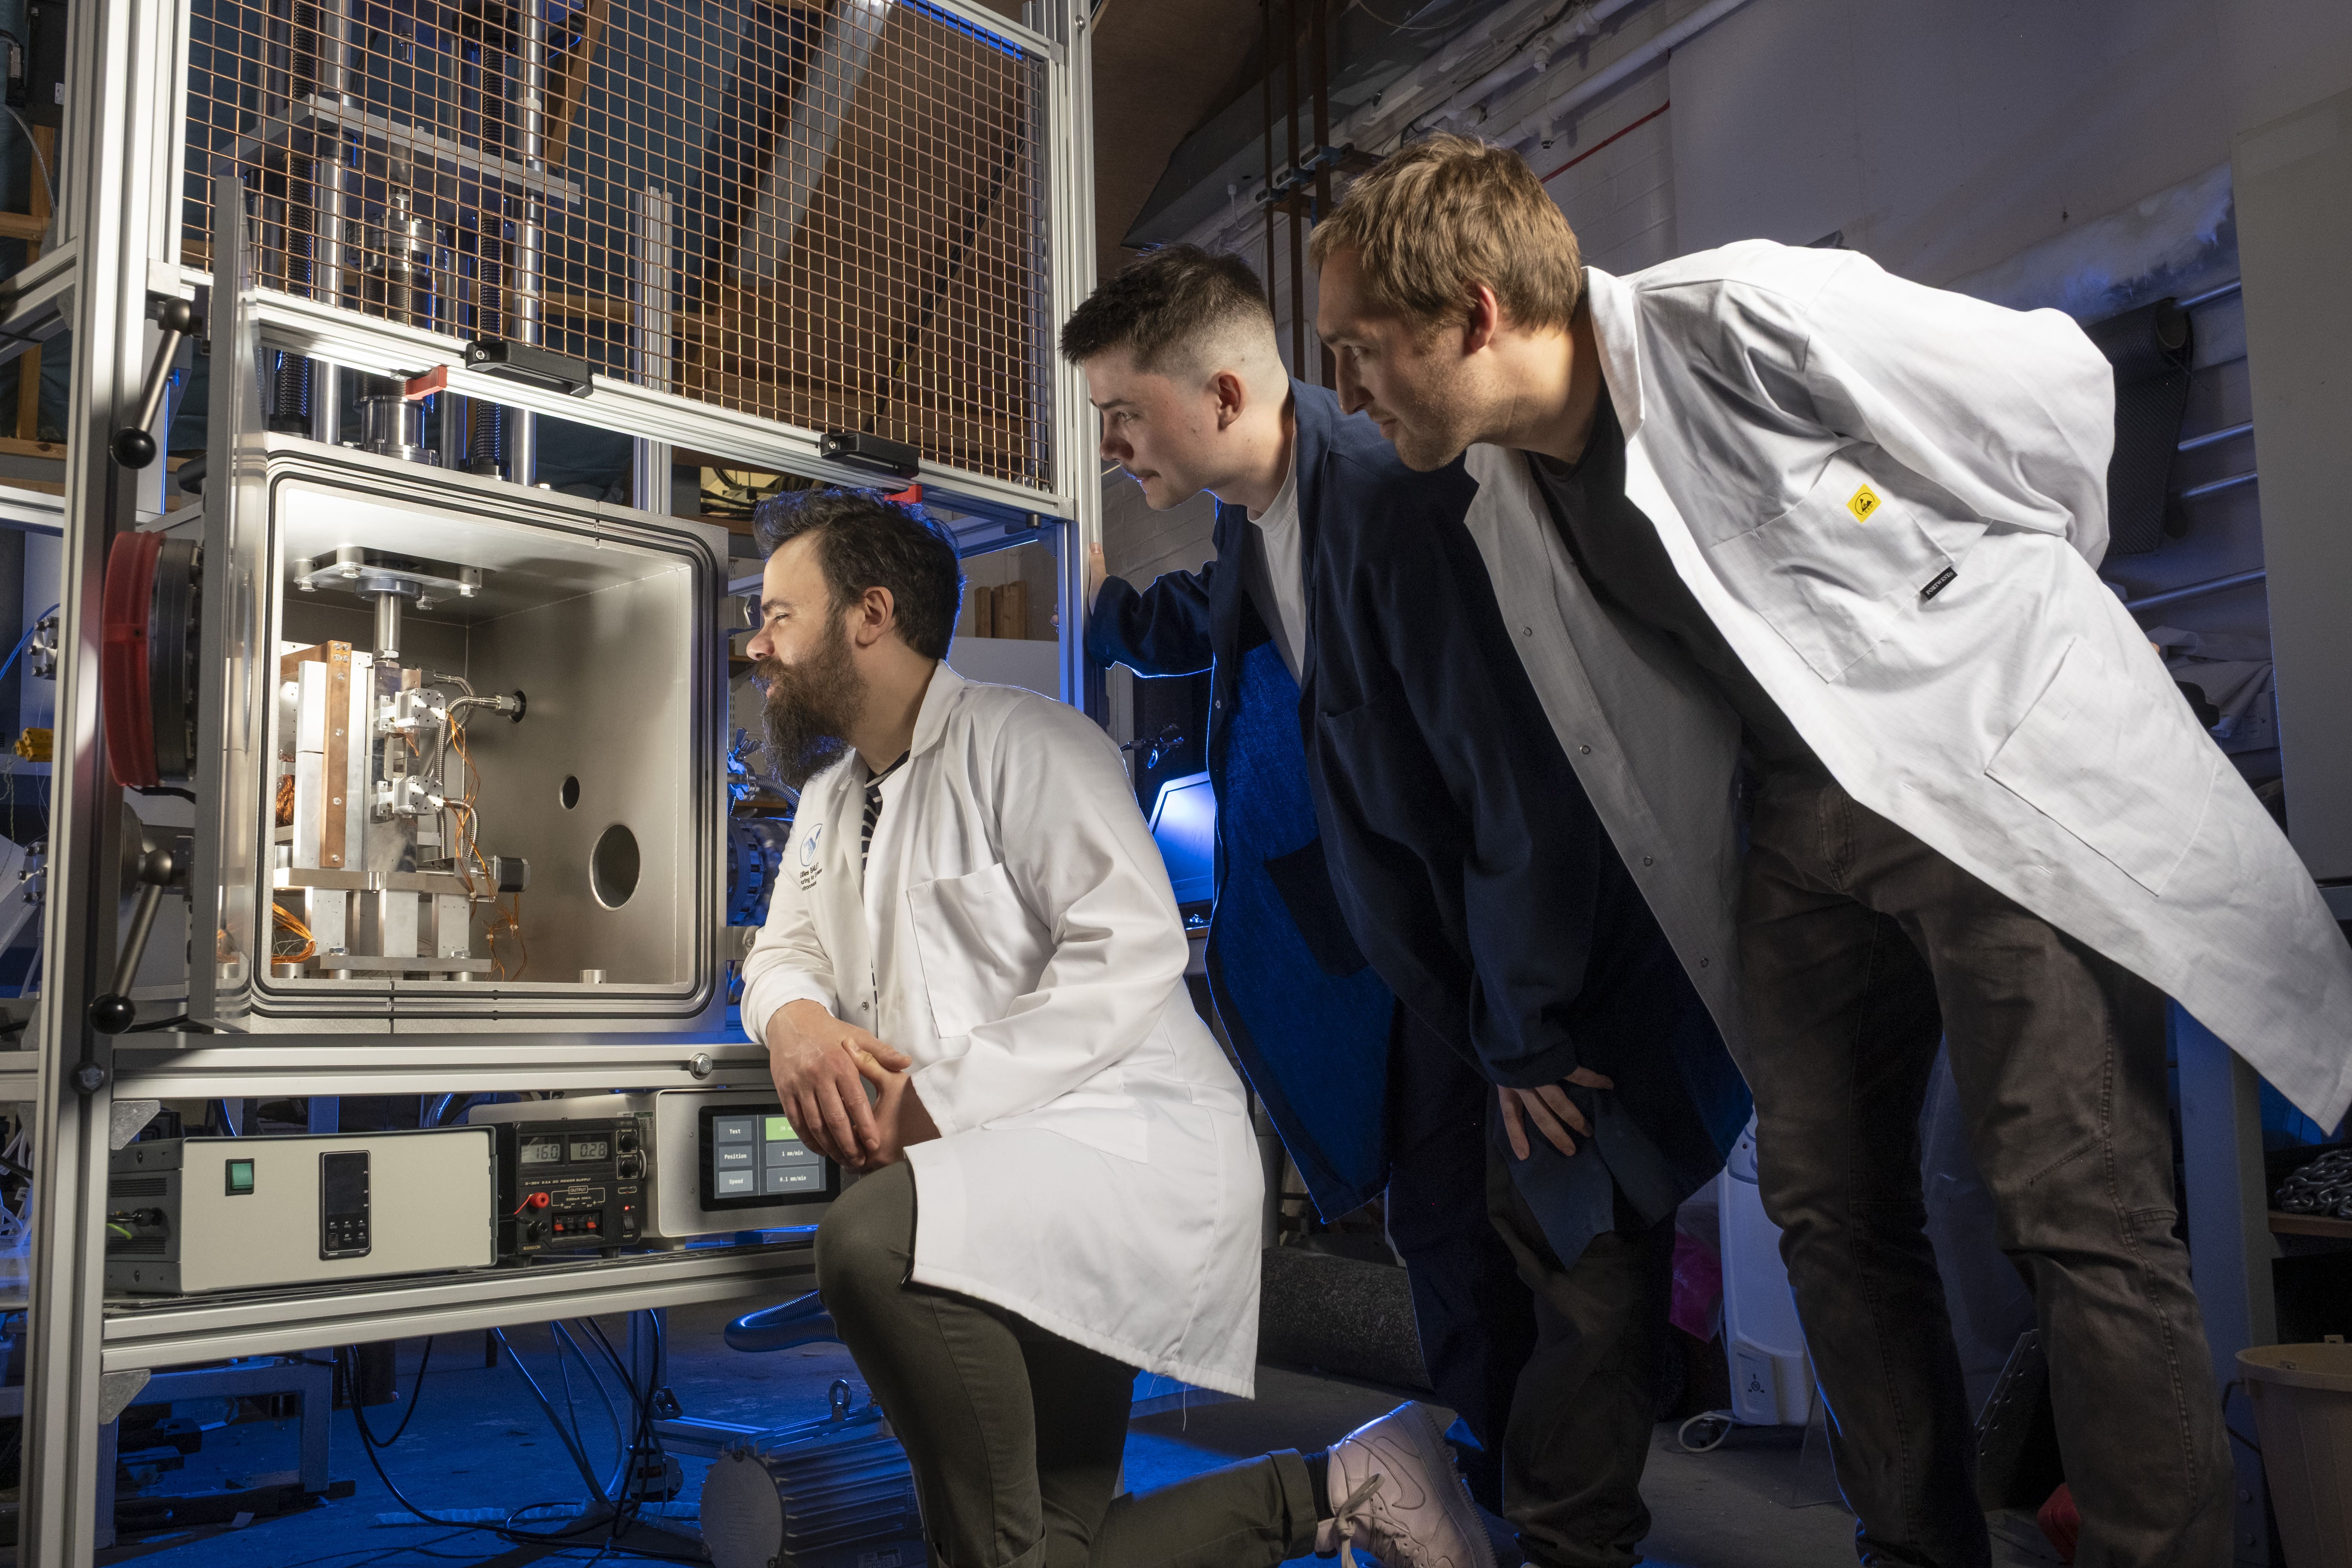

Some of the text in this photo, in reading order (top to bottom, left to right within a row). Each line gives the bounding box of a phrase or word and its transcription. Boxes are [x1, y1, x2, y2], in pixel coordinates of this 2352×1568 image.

[1865, 504, 1873, 513] ESD
[536, 1144, 559, 1159] 16.0
[580, 1142, 606, 1157] 0.28
